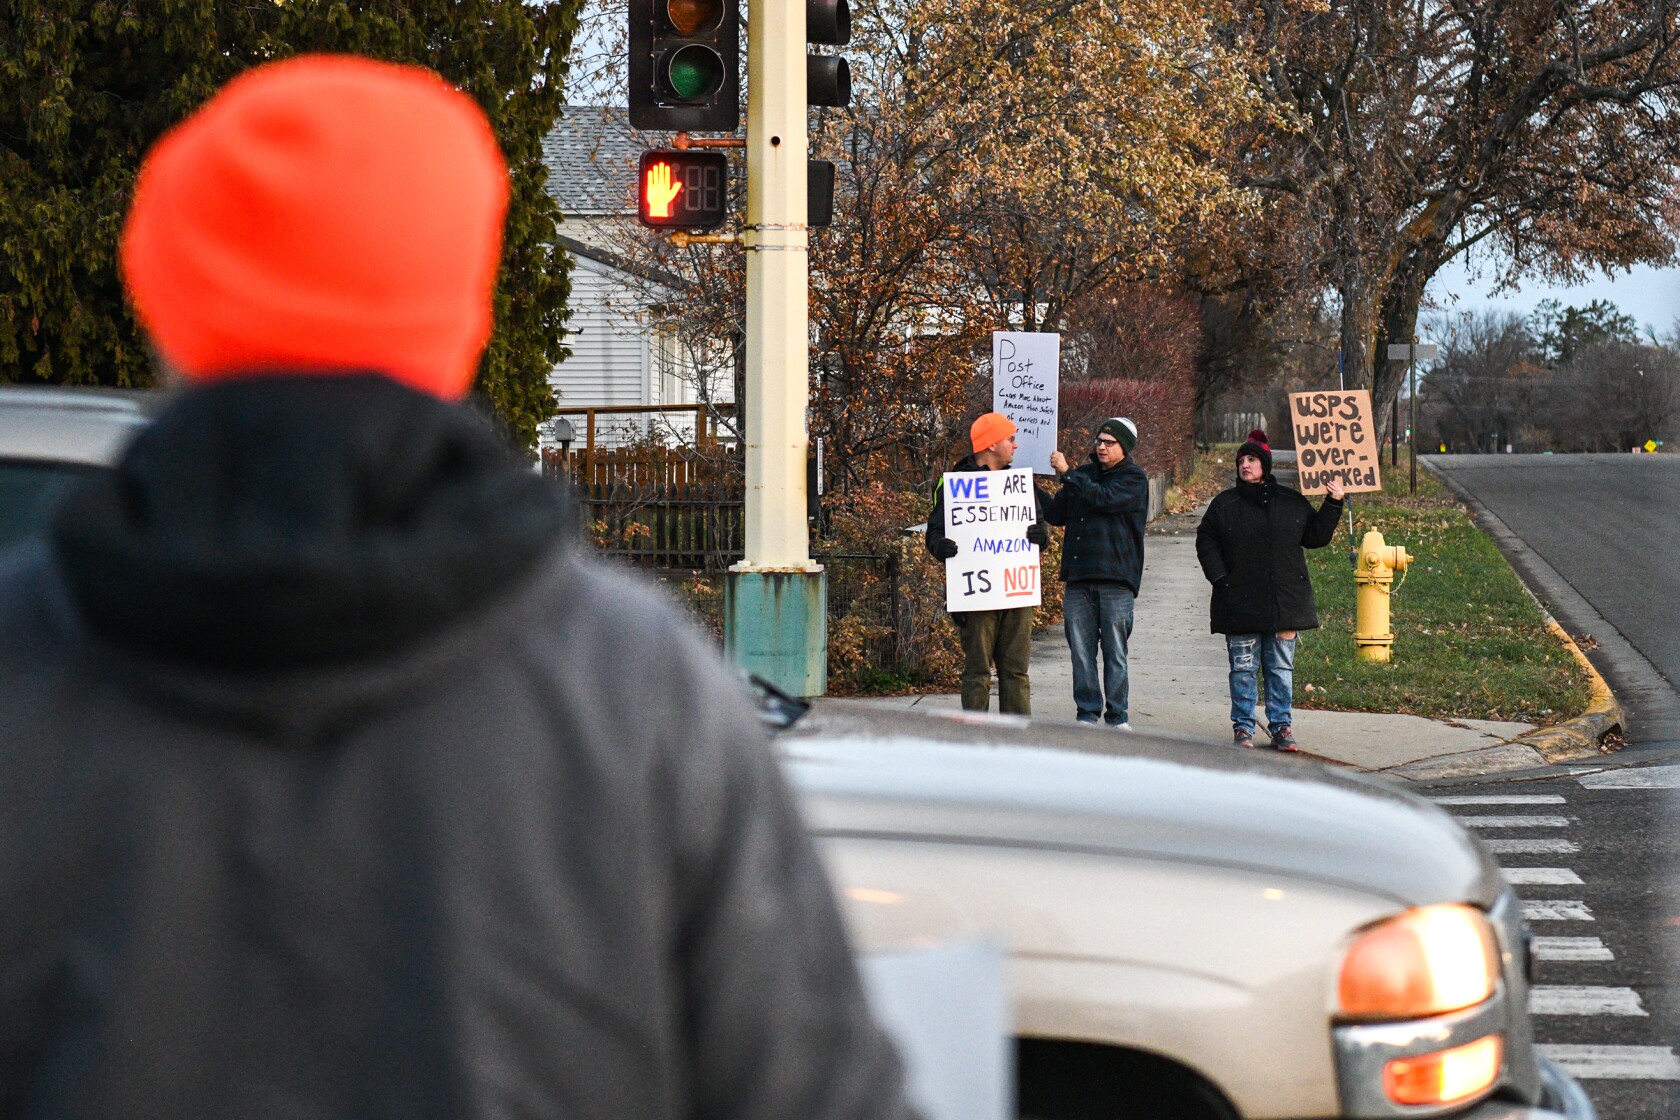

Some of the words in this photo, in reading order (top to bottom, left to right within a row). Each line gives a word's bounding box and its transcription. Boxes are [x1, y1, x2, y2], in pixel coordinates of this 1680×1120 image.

[999, 339, 1034, 375] Post
[1012, 375, 1045, 390] Office
[1007, 413, 1014, 421] of
[949, 477, 989, 499] WE
[1003, 474, 1027, 495] ARE
[1301, 467, 1376, 489] worked
[951, 506, 1034, 526] ESSENTIAL
[973, 537, 1032, 554] AMAZON
[962, 569, 992, 596] IS
[1004, 565, 1038, 592] NOT
